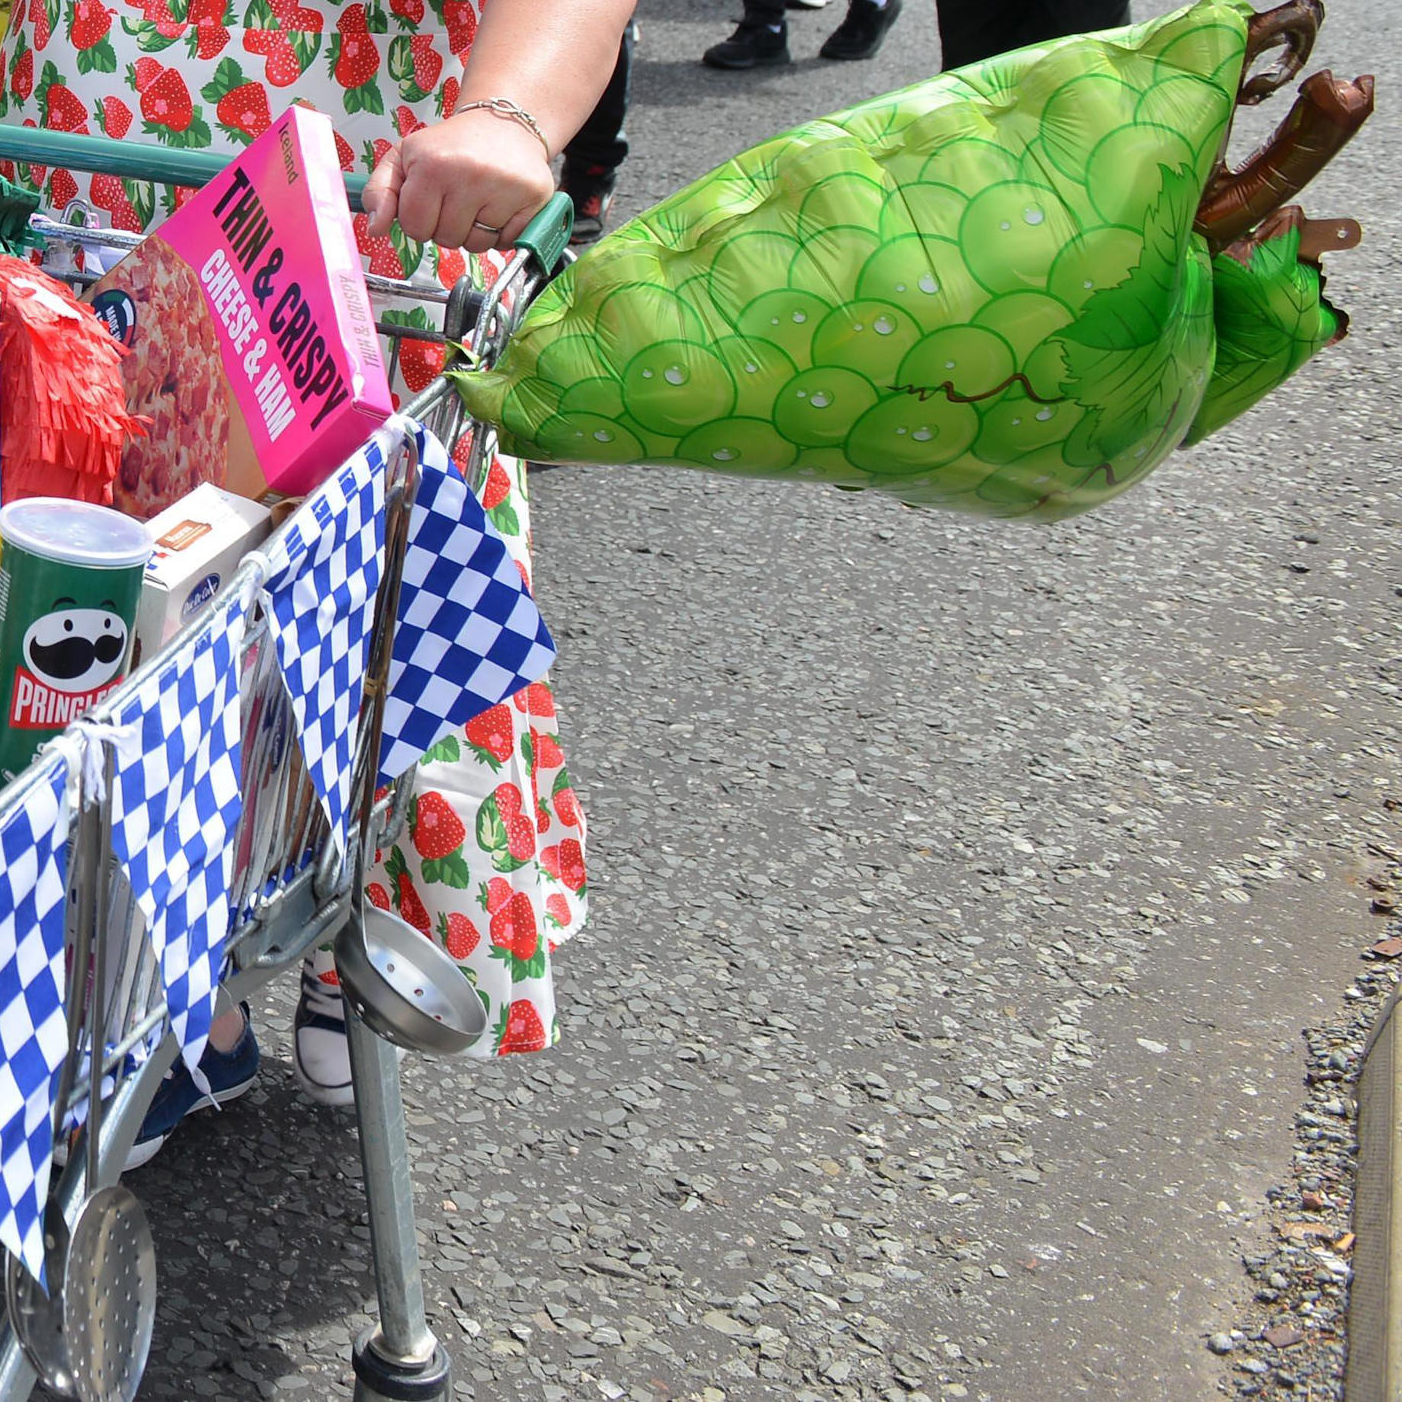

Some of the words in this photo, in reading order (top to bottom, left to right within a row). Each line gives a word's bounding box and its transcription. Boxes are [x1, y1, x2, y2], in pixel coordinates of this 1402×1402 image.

[278, 122, 299, 185] Iceland
[105, 305, 120, 334] MADE
[200, 248, 260, 356] CHEESE
[212, 166, 276, 275] THIN
[252, 248, 284, 310] &
[269, 282, 350, 431] CRISPY
[243, 338, 268, 383] &
[254, 362, 296, 443] HAM
